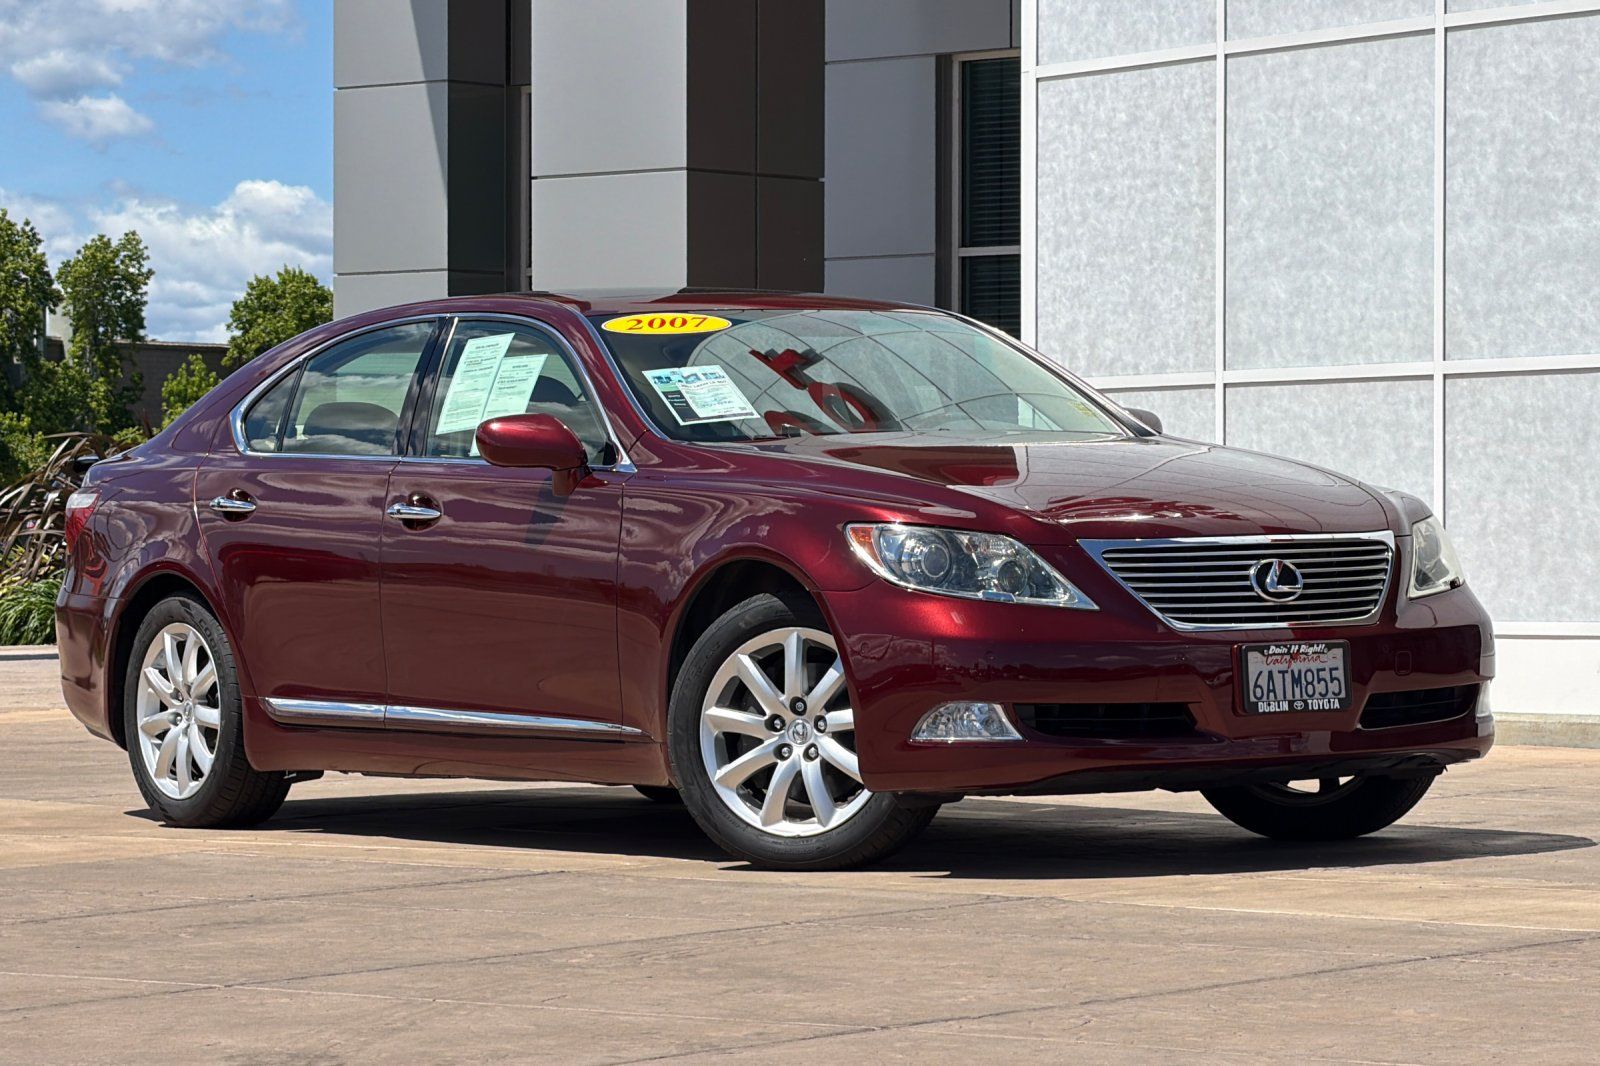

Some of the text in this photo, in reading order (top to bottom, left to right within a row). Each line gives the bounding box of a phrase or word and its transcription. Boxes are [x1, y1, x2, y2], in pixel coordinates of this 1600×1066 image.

[626, 316, 708, 330] 2007
[1268, 643, 1325, 655] Doin' It Right!
[1265, 654, 1328, 669] Califrnia
[1252, 667, 1342, 701] 6ATM855
[1258, 698, 1340, 712] DUBLIN TOYOTA
